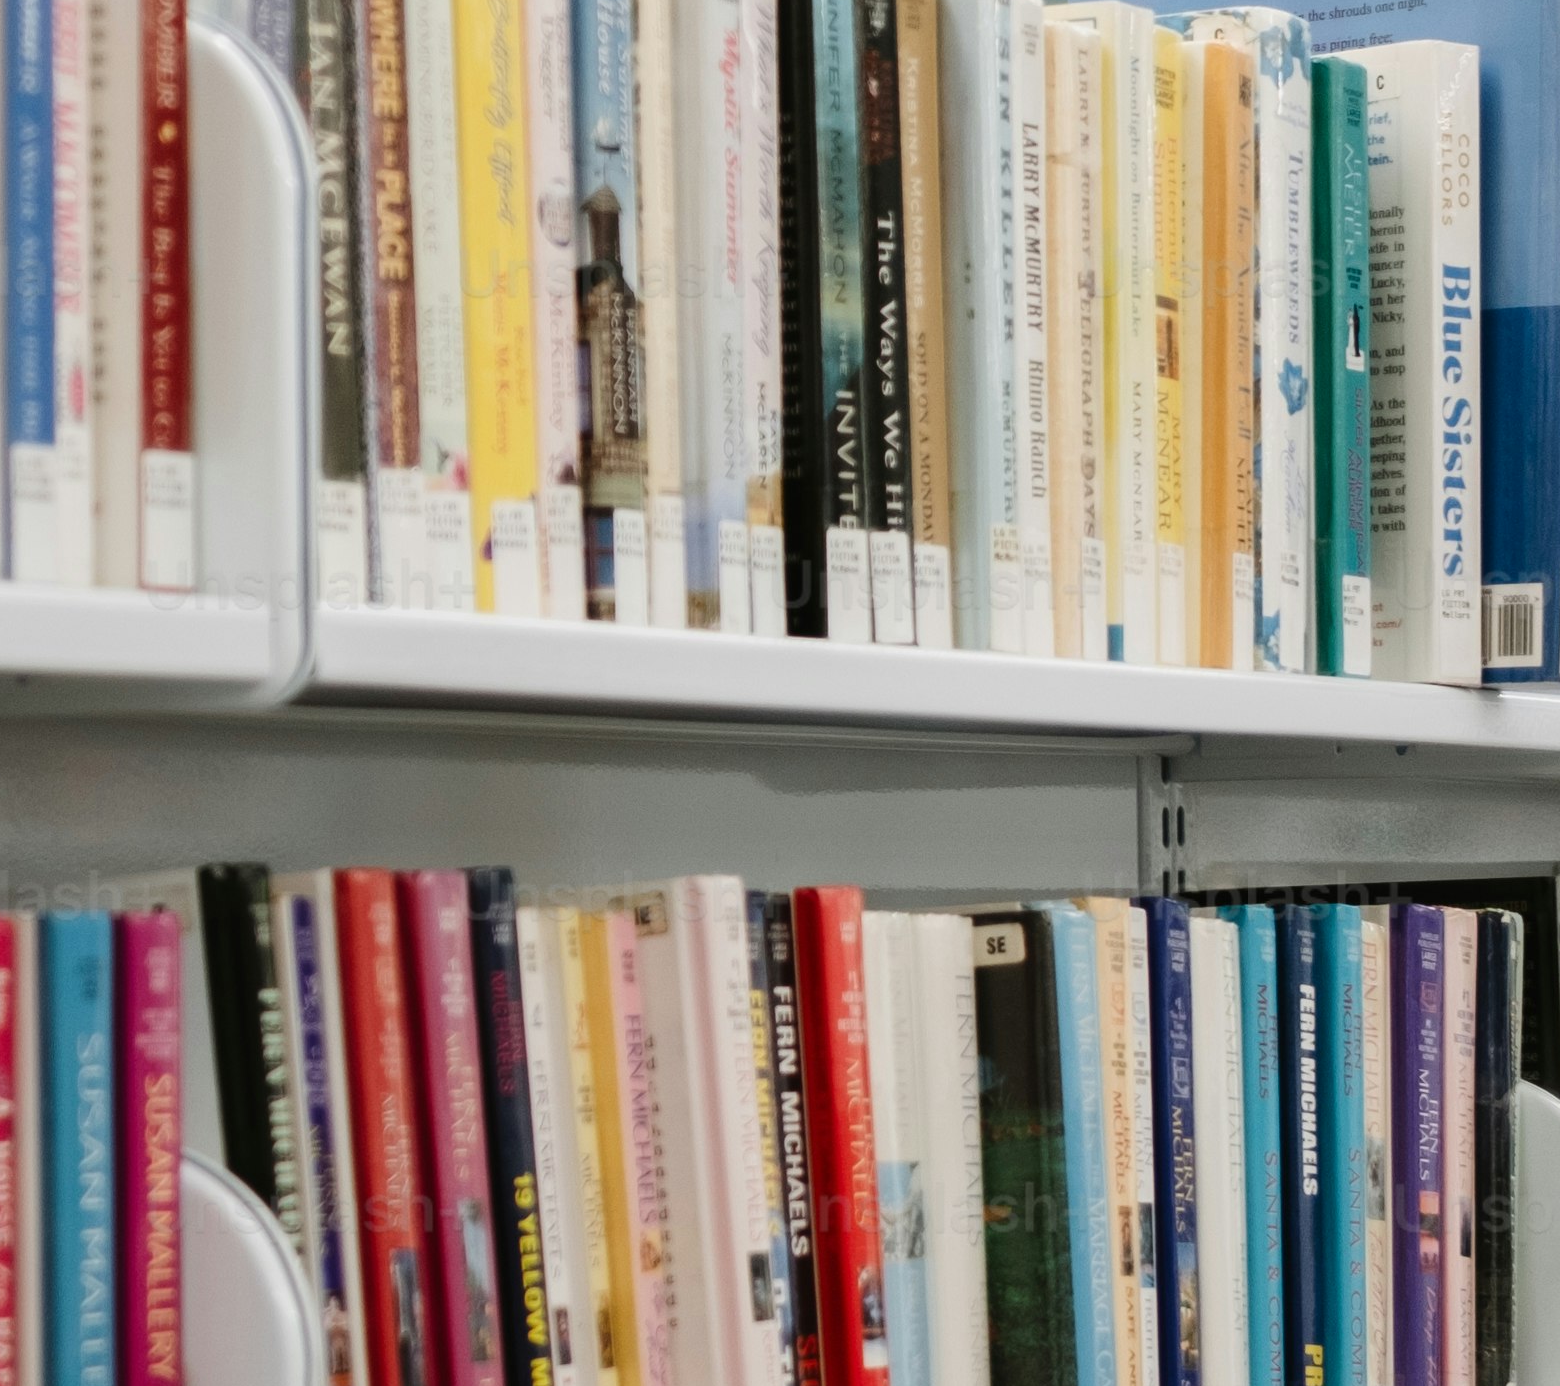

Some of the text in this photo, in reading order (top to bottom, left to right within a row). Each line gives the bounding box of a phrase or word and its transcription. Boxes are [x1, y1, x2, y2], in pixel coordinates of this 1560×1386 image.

[722, 30, 738, 286] Mystic Summer
[998, 35, 1014, 344] SIN KILLER
[1457, 134, 1470, 207] COCO
[375, 170, 408, 280] PLACE
[1442, 264, 1473, 576] Blue Sisters
[986, 935, 1007, 954] SE
[1256, 983, 1269, 1100] MICHAELS
[1298, 984, 1319, 1198] FERN MICHAELS
[1341, 983, 1354, 1097] MICHAELS
[76, 1032, 106, 1212] SUSAN
[773, 985, 809, 1258] FERN MICHAELS
[1417, 1068, 1430, 1180] MICHAELS
[1428, 1099, 1440, 1154] FERN
[144, 1072, 179, 1381] SUSAN MALLERY
[514, 1174, 535, 1209] 19
[518, 1213, 549, 1345] YELLOW
